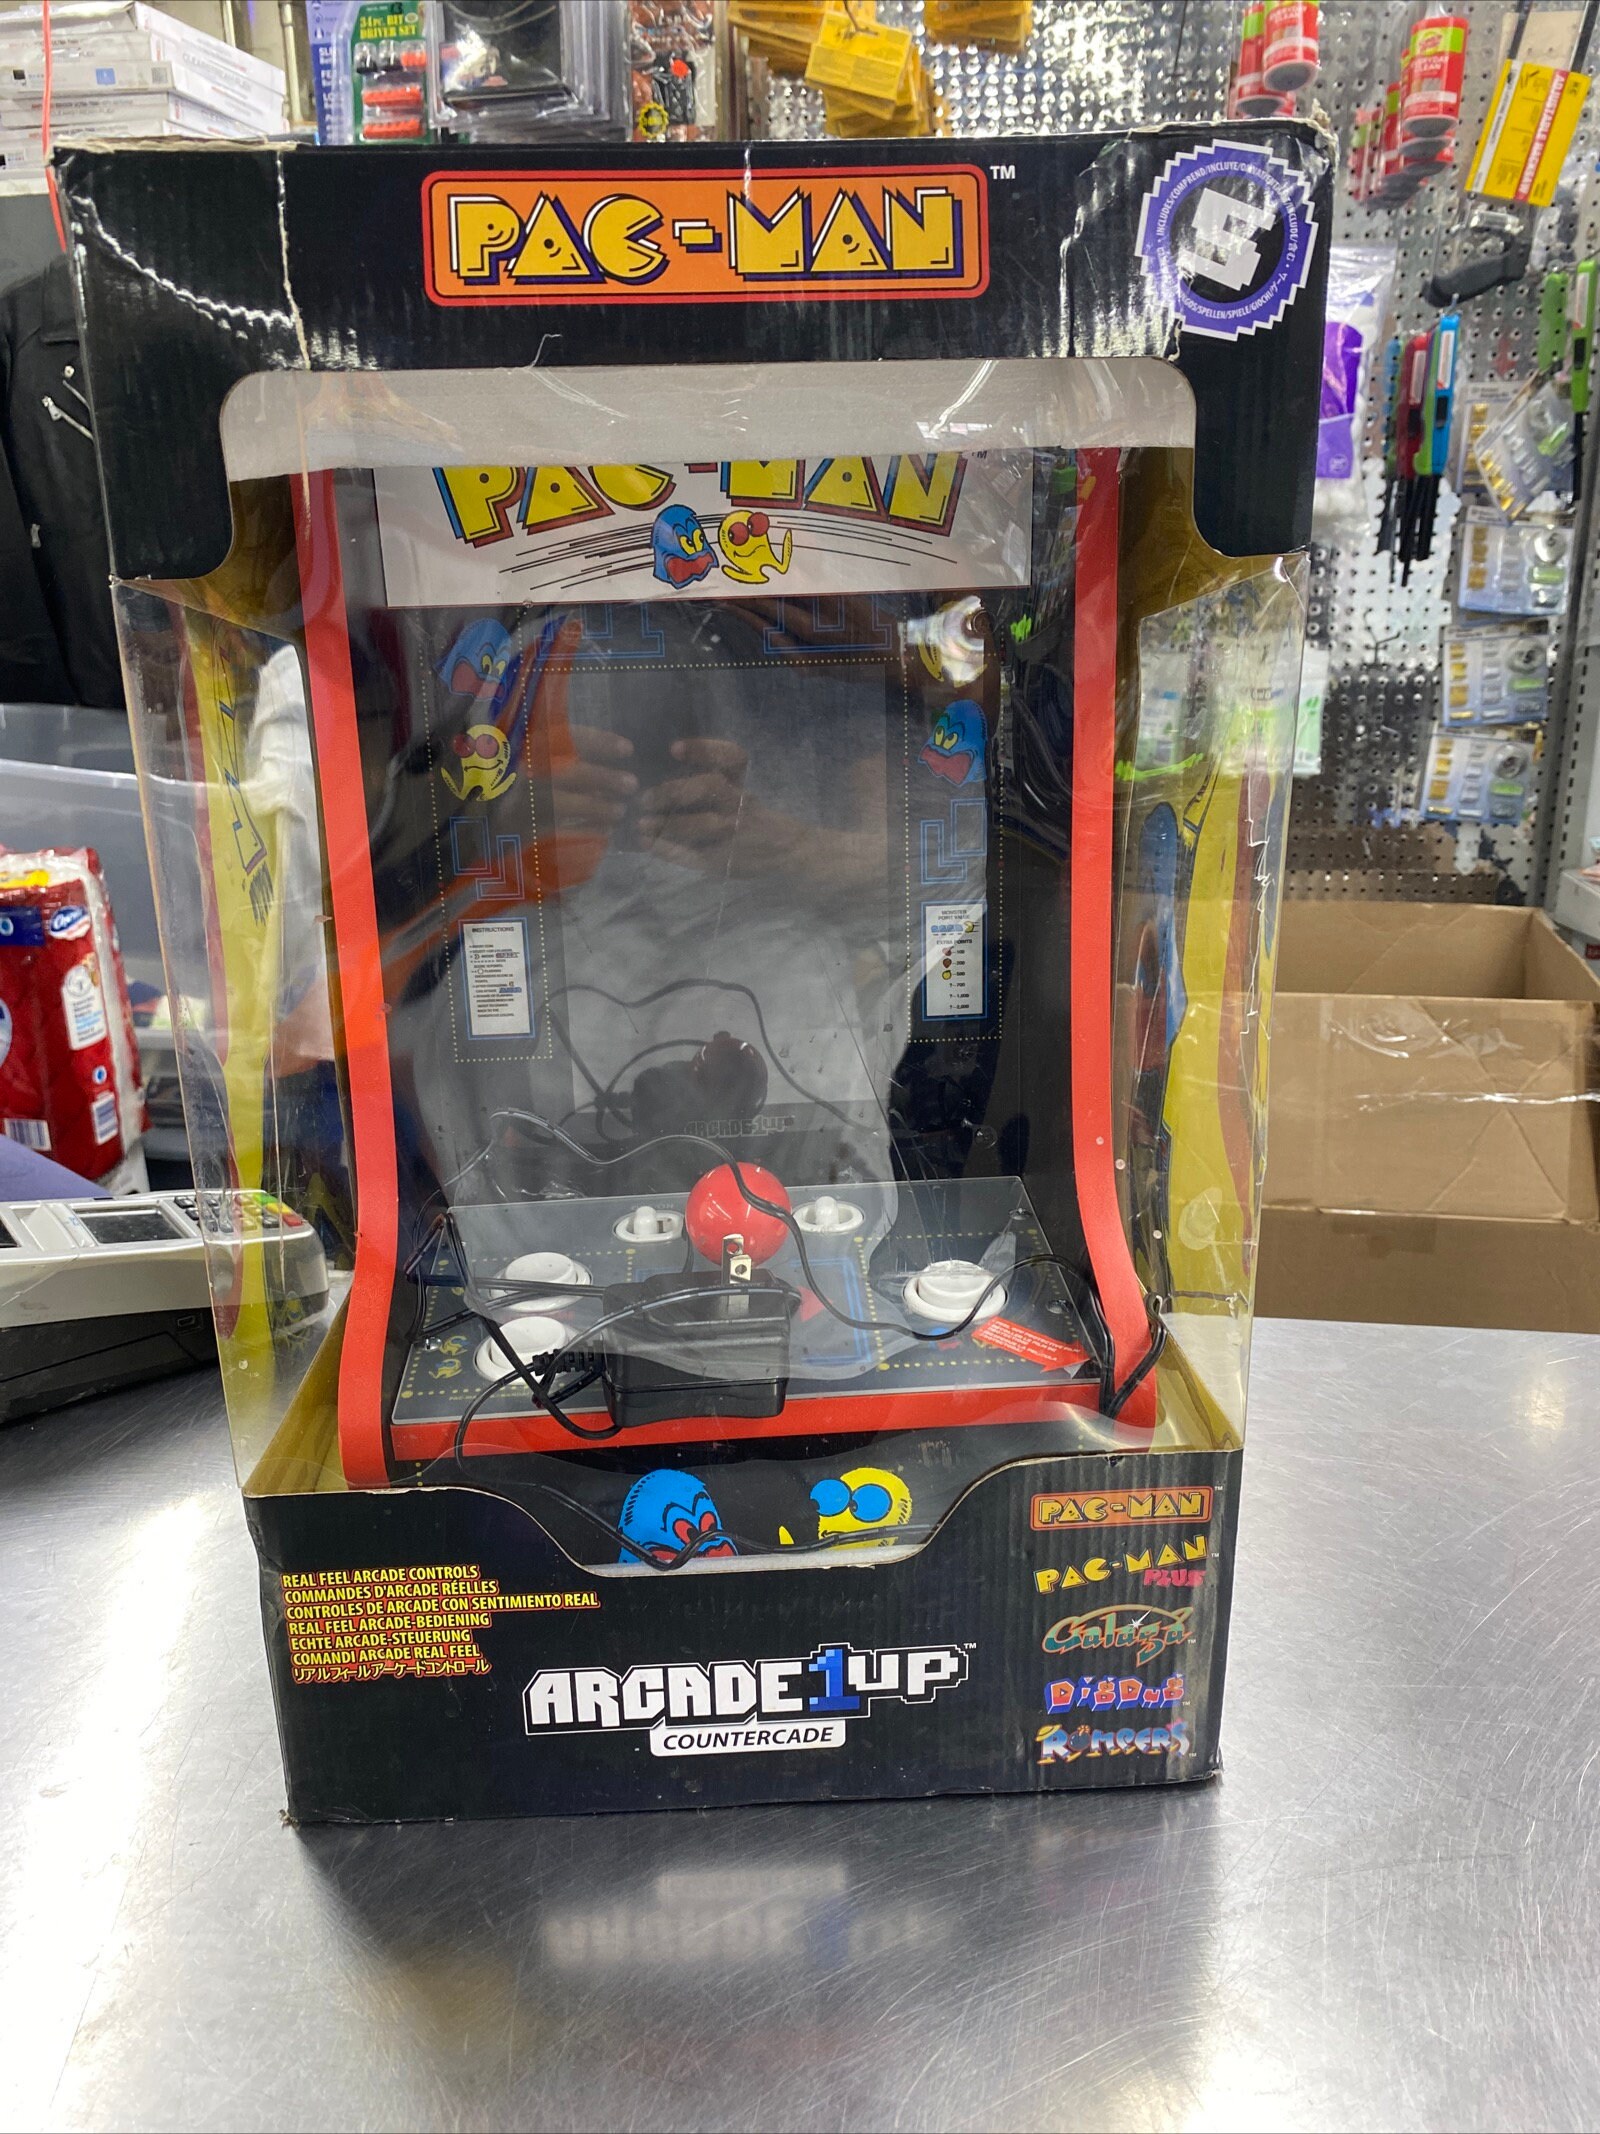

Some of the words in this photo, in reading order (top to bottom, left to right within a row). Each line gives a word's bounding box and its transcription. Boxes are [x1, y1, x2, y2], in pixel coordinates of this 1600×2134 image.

[448, 186, 964, 286] PAC-MAN
[1038, 1491, 1205, 1524] PAC-MAN
[282, 1574, 317, 1588] REAL
[319, 1572, 351, 1586] FEEL
[353, 1568, 407, 1583] ARCADE
[409, 1565, 479, 1581] CONTROLS
[1034, 1535, 1207, 1595] PAC-MAN
[1143, 1568, 1206, 1588] PLUS
[284, 1586, 371, 1604] COMMANDES
[374, 1582, 439, 1599] D'ARCADE
[441, 1579, 498, 1596] RÉELLES
[286, 1603, 364, 1620] CONTROLES
[366, 1601, 385, 1616] DE
[386, 1599, 440, 1614] ARCADE
[441, 1598, 469, 1612] CON
[471, 1594, 562, 1611] SENTIMIENTO
[564, 1592, 598, 1607] REAL
[289, 1622, 323, 1636] REAL
[325, 1619, 357, 1634] FEEL
[358, 1612, 490, 1632] ARCADE-BEDIENING
[1042, 1604, 1194, 1668] Galaga
[291, 1637, 332, 1651] ECHTE
[335, 1629, 471, 1649] ARCADE-STEUERUNG
[293, 1651, 356, 1666] COMANDI
[358, 1647, 412, 1663] ARCADE
[413, 1645, 447, 1660] REAL
[449, 1644, 481, 1658] FEEL
[294, 1660, 490, 1682] リアルフィールアーケードコントロール
[526, 1645, 964, 1730] ARCADE1UP
[662, 1726, 834, 1751] COUNTERCADE
